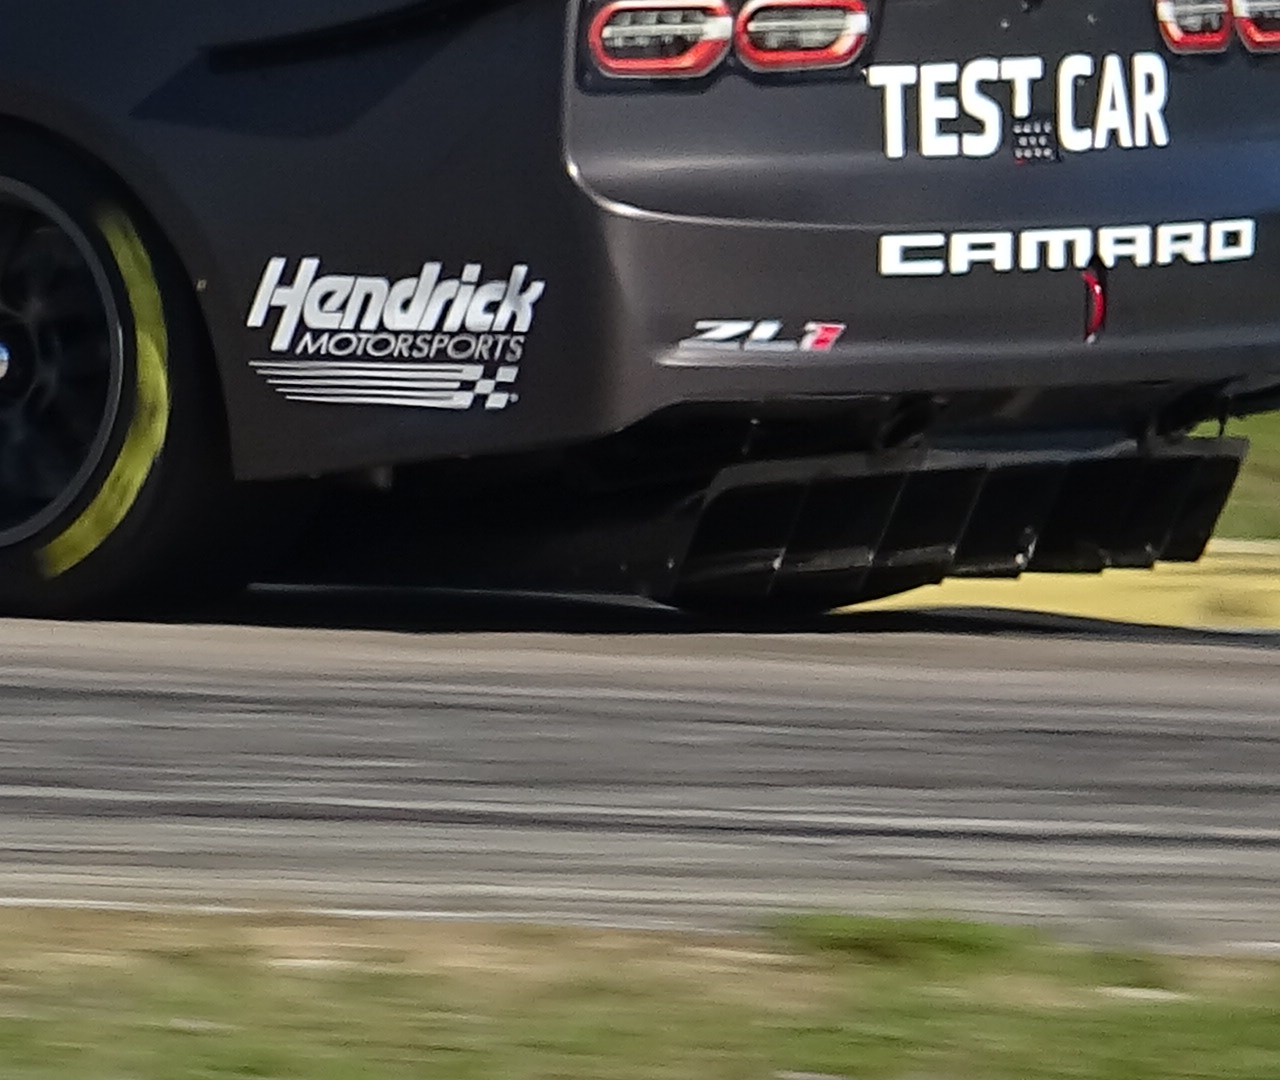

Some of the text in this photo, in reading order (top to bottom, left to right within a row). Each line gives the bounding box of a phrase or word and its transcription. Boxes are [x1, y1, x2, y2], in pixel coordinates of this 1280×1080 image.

[866, 51, 1171, 159] TEST CAR
[878, 218, 1257, 277] CAMARO
[246, 256, 546, 352] Hendrick
[294, 331, 526, 362] MOTORSPORTS
[678, 319, 847, 353] ZL1
